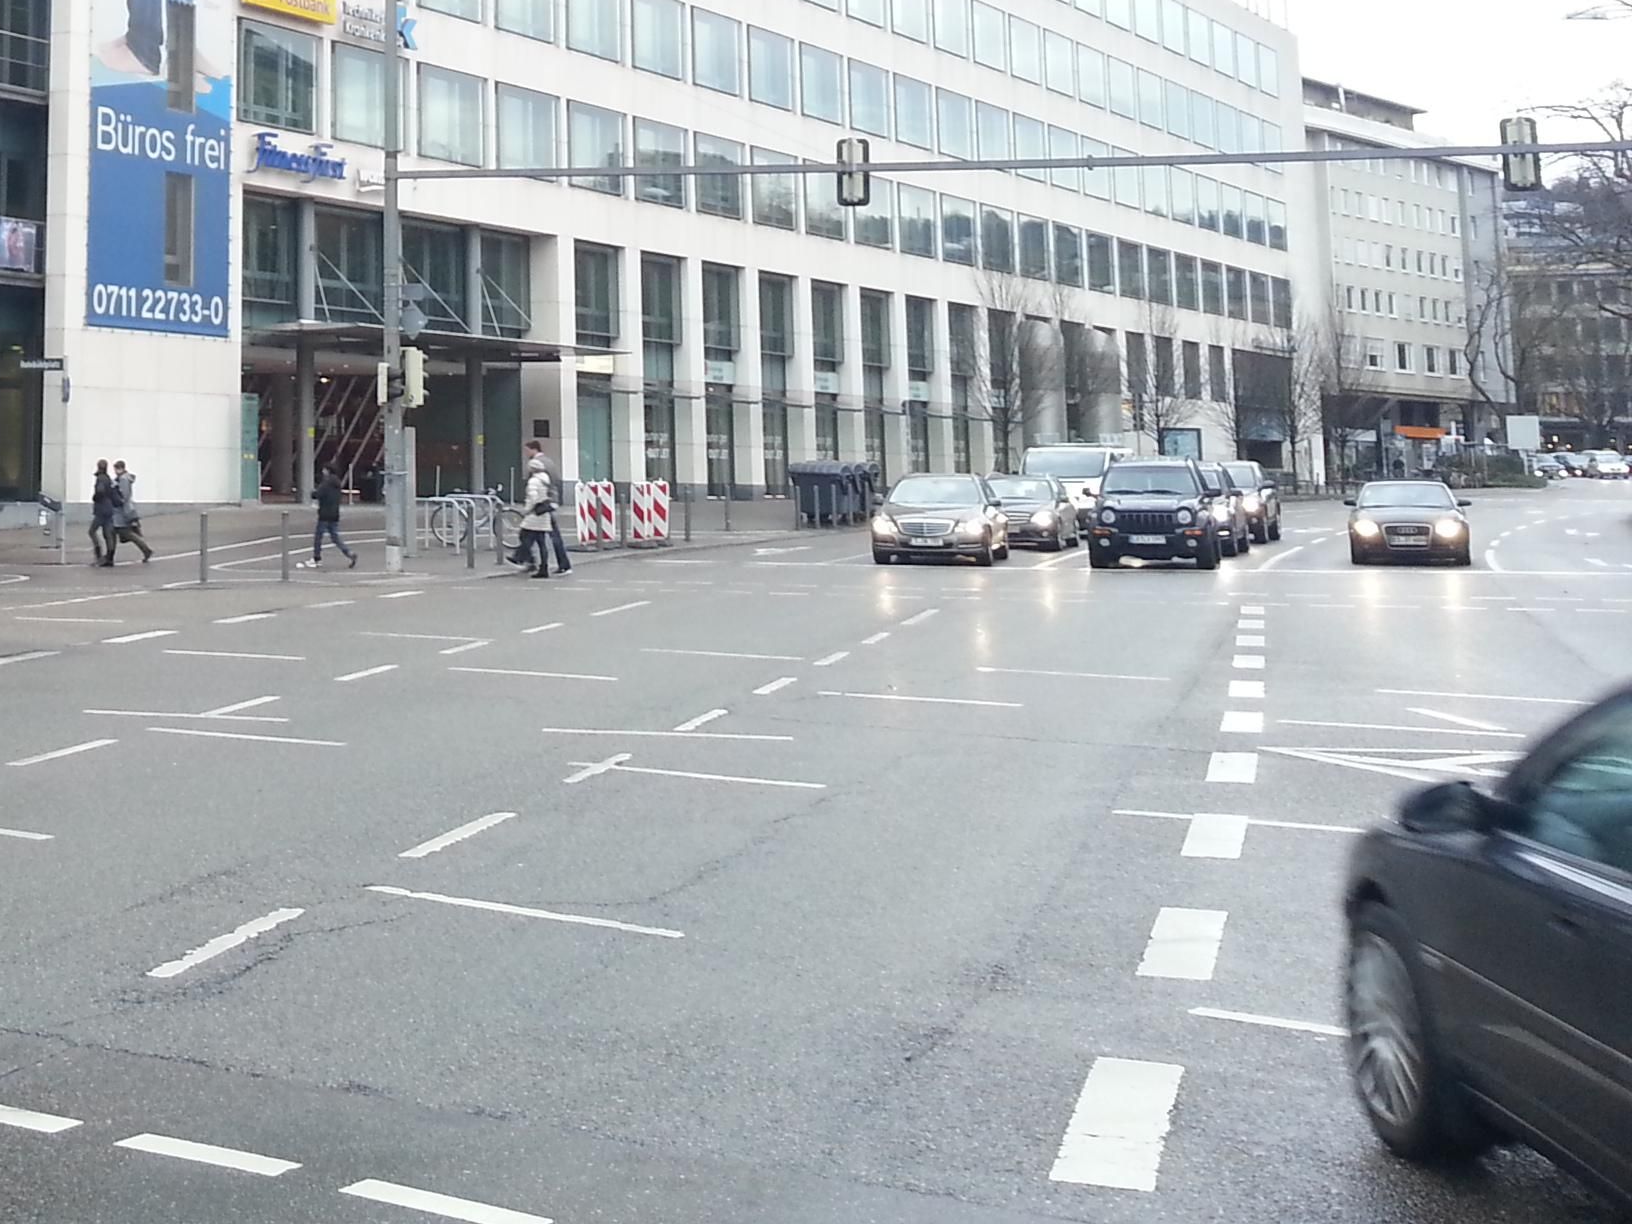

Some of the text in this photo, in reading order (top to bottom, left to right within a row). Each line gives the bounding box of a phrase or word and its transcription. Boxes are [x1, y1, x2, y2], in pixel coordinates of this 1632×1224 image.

[96, 105, 226, 170] Büros frei
[93, 283, 224, 325] 0711 22733-0
